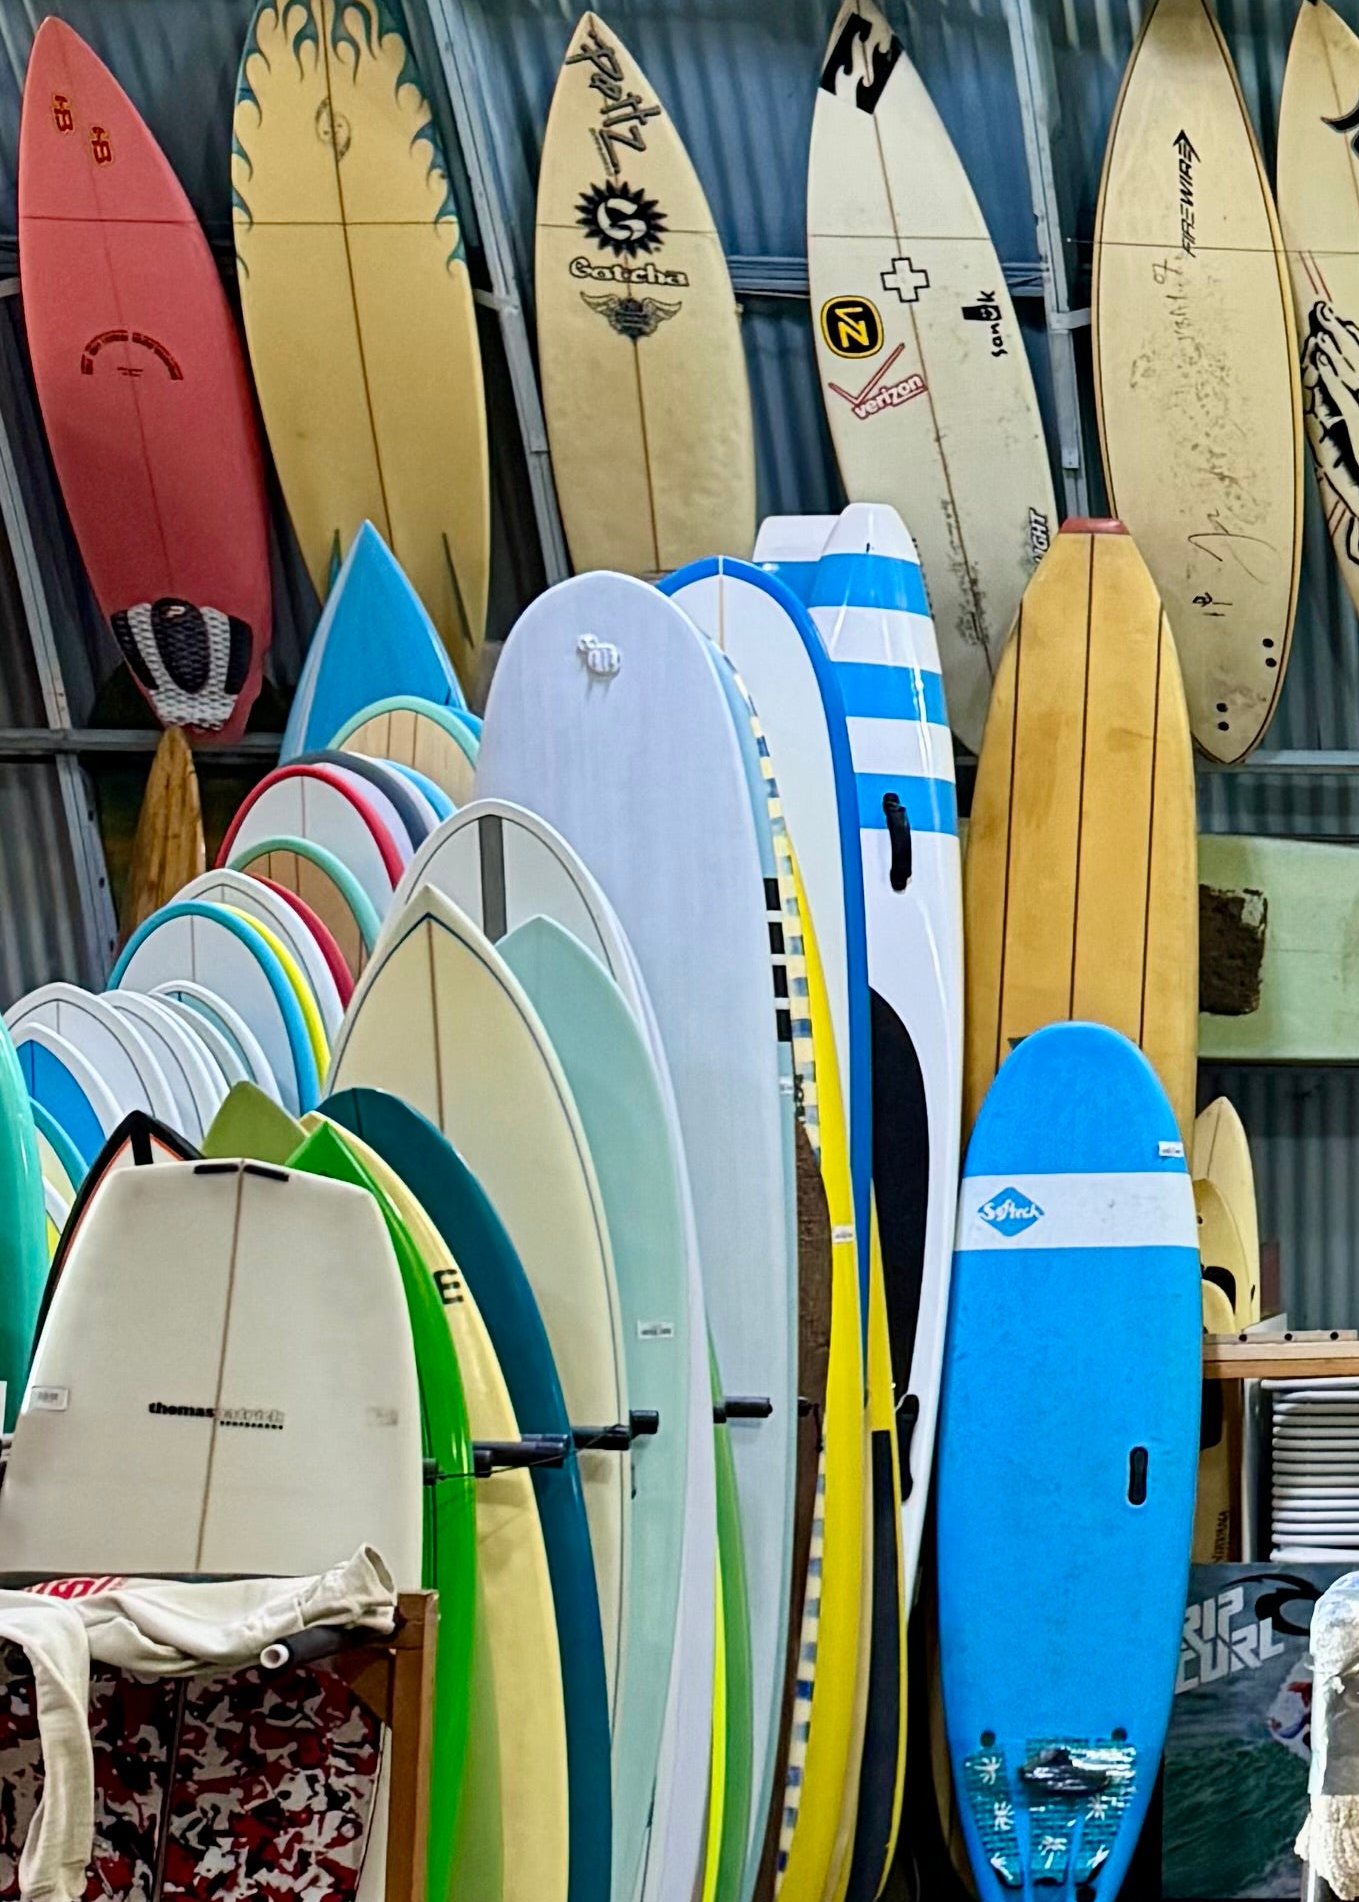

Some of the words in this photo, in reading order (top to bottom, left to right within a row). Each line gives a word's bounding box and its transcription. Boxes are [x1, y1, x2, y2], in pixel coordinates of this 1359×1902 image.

[1178, 141, 1201, 258] FIREWIRE
[569, 256, 690, 287] Gotcha
[852, 373, 928, 420] verizon
[149, 1402, 215, 1418] thomas
[1183, 1587, 1244, 1643] RIP
[1174, 1617, 1285, 1696] CURL
